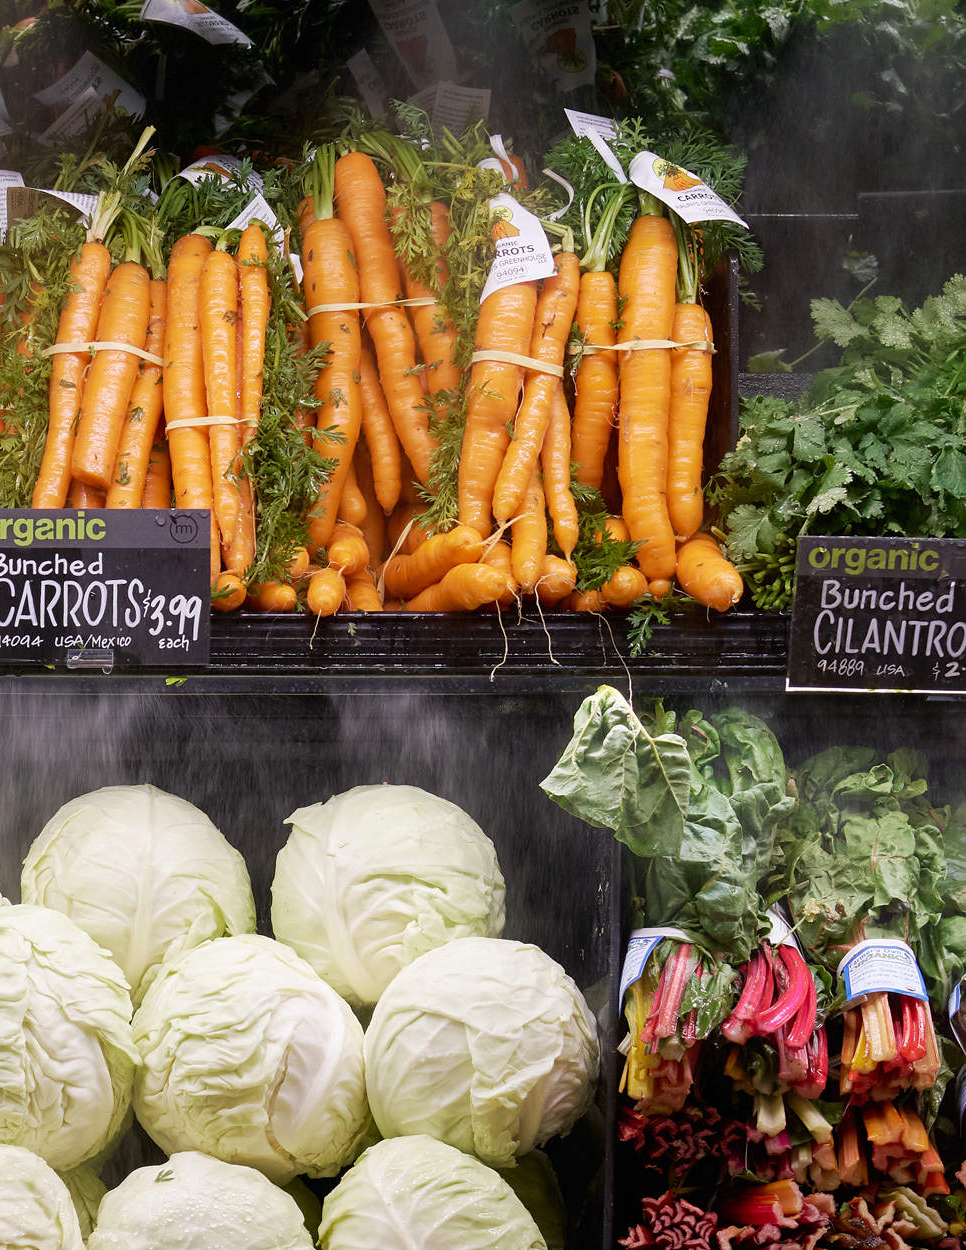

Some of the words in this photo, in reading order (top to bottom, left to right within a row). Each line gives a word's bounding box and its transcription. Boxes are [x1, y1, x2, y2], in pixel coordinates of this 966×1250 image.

[499, 252, 547, 267] GREENHOUSE
[496, 266, 524, 279] 94094
[808, 542, 940, 575] organic
[821, 579, 955, 614] Bunched
[143, 589, 202, 641] $3.99
[54, 634, 132, 649] USA/Mexico
[159, 634, 190, 652] each
[813, 609, 966, 658] CILANTRO
[817, 659, 864, 676] 94889
[876, 664, 905, 677] USA
